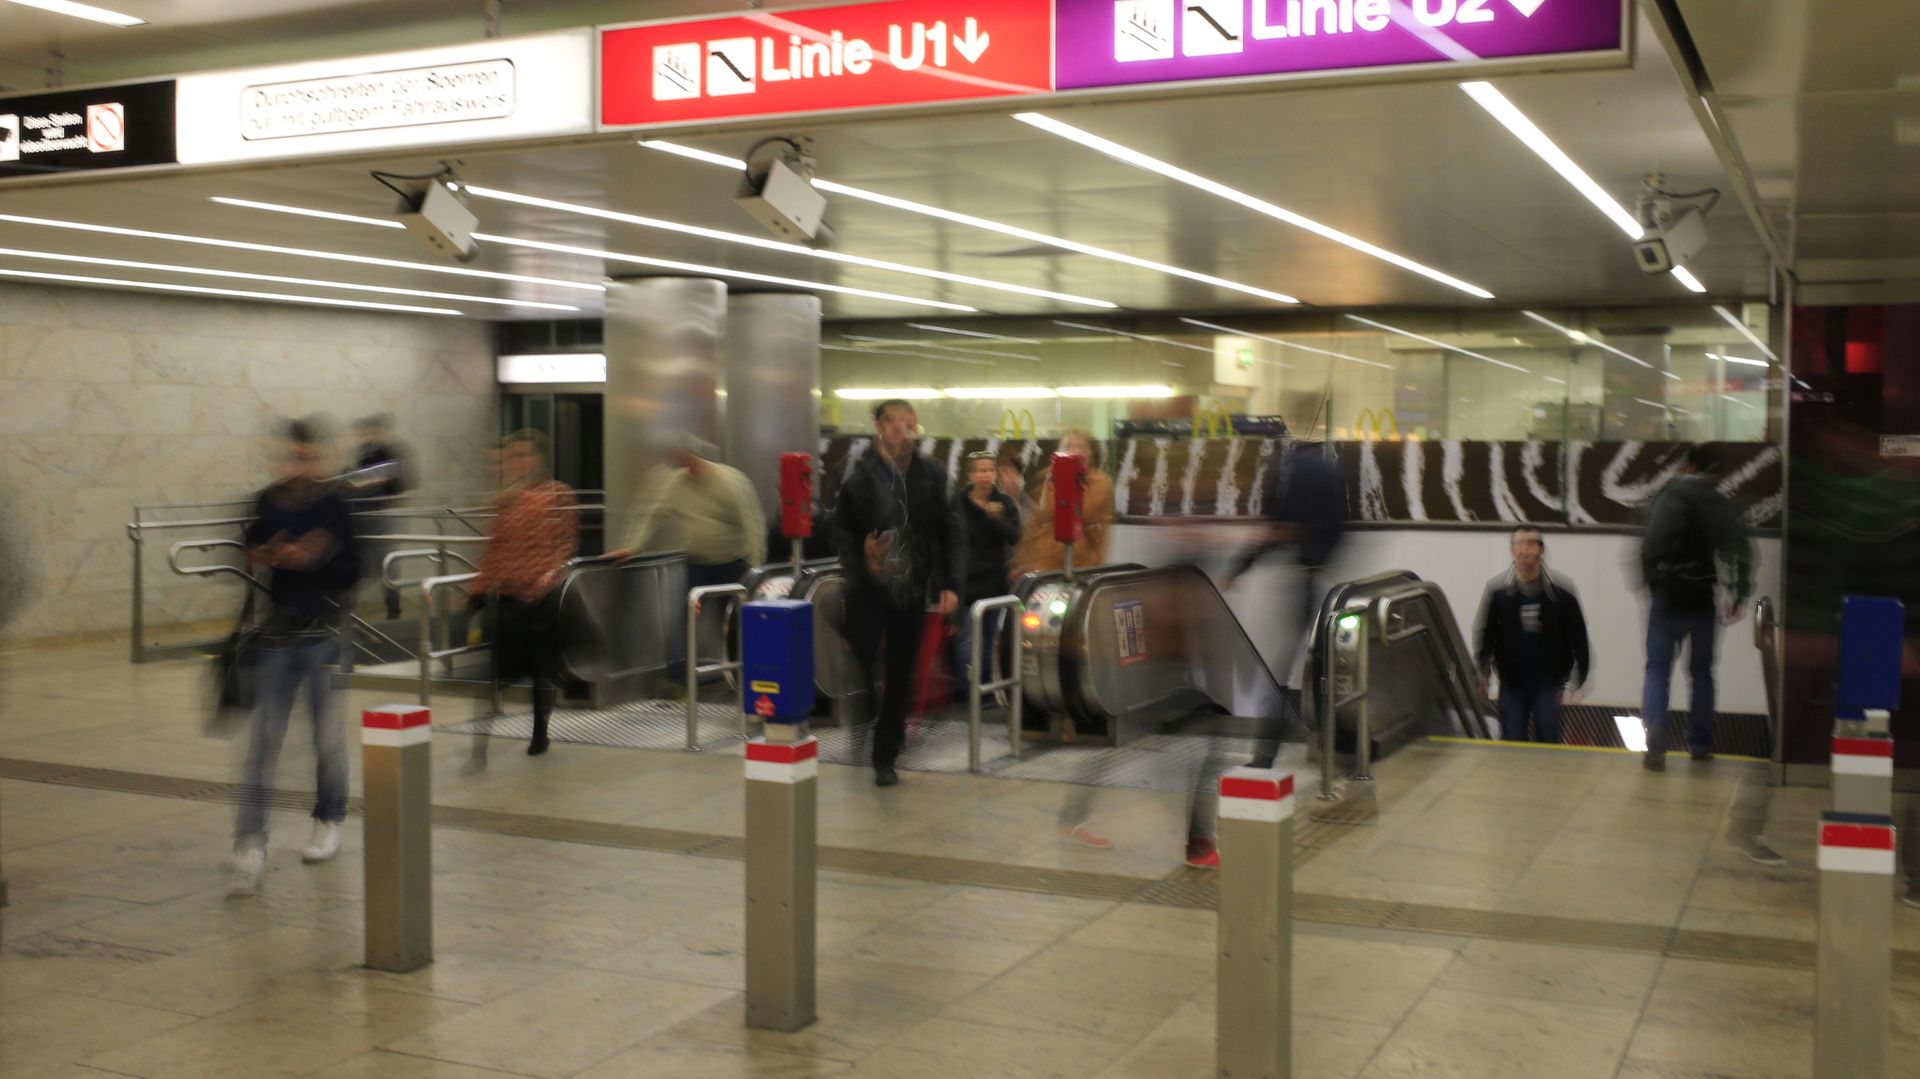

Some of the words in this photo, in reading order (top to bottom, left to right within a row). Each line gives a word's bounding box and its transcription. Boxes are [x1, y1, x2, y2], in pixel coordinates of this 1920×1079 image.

[1251, 0, 1392, 40] Linie
[762, 30, 874, 82] Linie
[888, 21, 947, 71] U1
